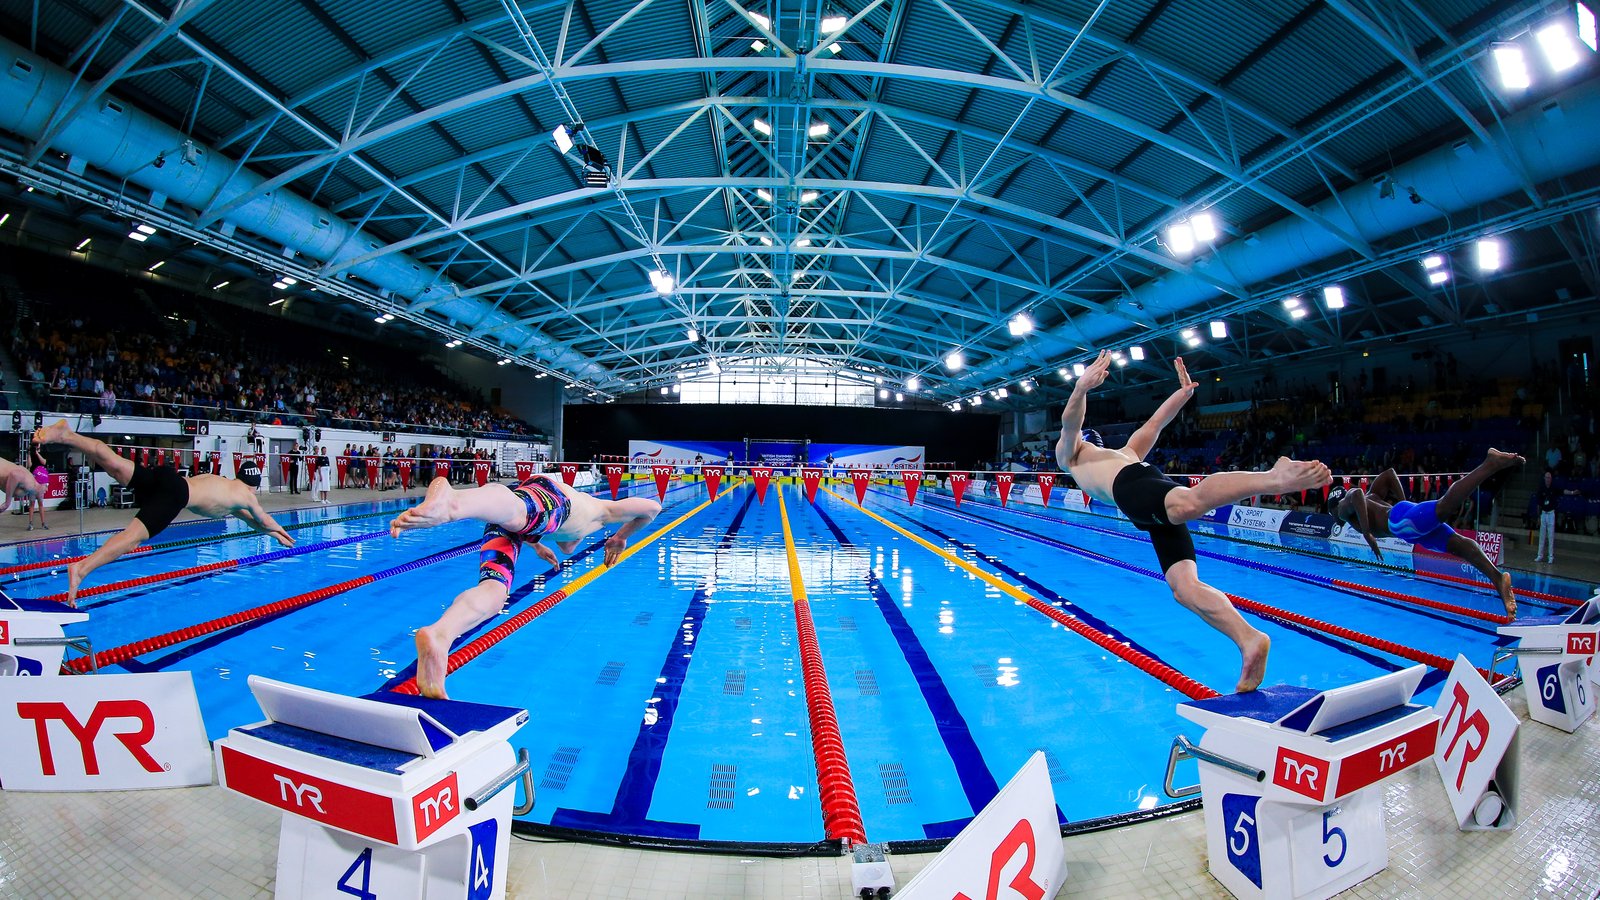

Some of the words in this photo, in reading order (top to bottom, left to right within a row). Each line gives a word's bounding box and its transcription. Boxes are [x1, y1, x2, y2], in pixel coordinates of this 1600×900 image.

[1243, 519, 1266, 527] SYSTEMS
[1476, 532, 1501, 543] PEOPLE
[1480, 542, 1499, 553] MAKE
[1571, 637, 1591, 650] TYR
[1543, 674, 1556, 700] 6
[1576, 674, 1585, 705] 6
[16, 700, 165, 775] TYR
[1440, 681, 1489, 792] TYR
[1283, 756, 1318, 790] TYR
[1380, 741, 1407, 772] TYR
[274, 773, 324, 814] TYR
[419, 786, 454, 827] TYR
[1230, 811, 1254, 856] 5
[1322, 809, 1347, 868] 5
[337, 848, 377, 900] 4
[474, 844, 489, 891] 4
